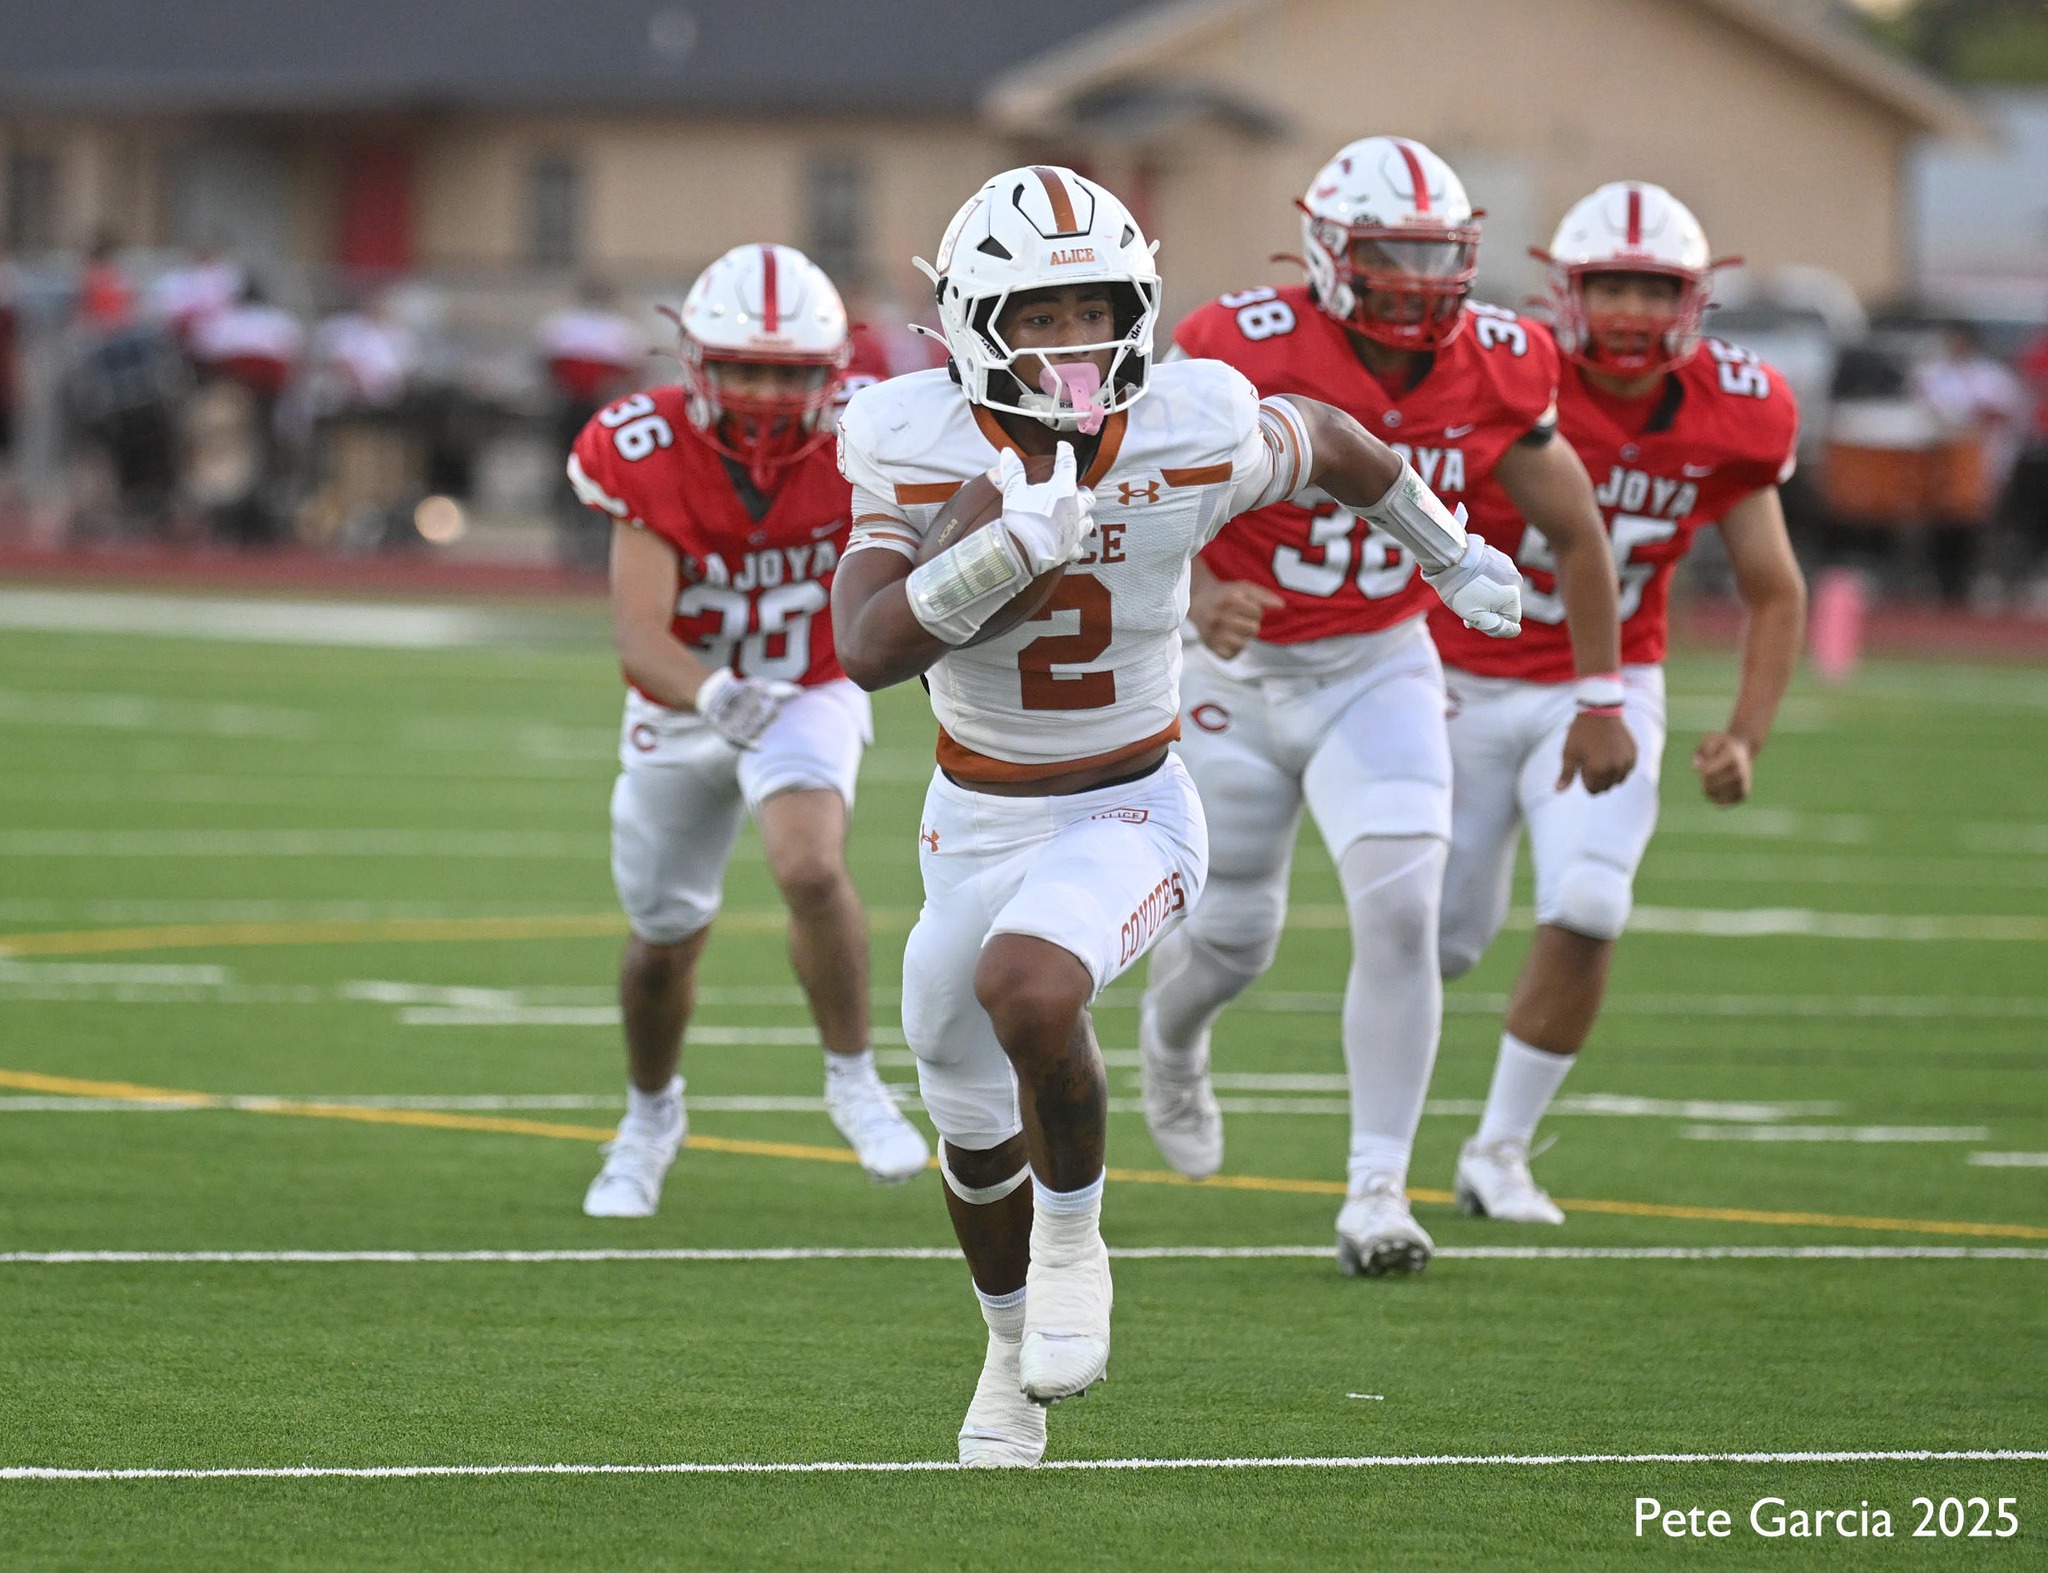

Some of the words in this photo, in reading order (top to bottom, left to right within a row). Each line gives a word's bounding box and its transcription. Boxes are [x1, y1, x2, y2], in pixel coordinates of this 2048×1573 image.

[1049, 247, 1096, 266] ALICE
[599, 393, 674, 462] 36
[1595, 465, 1699, 518] JOYA
[937, 517, 959, 547] NCAA
[732, 540, 839, 593] JOYA
[676, 578, 829, 685] 36
[1017, 572, 1117, 711] 2
[1119, 871, 1186, 969] COYOTES
